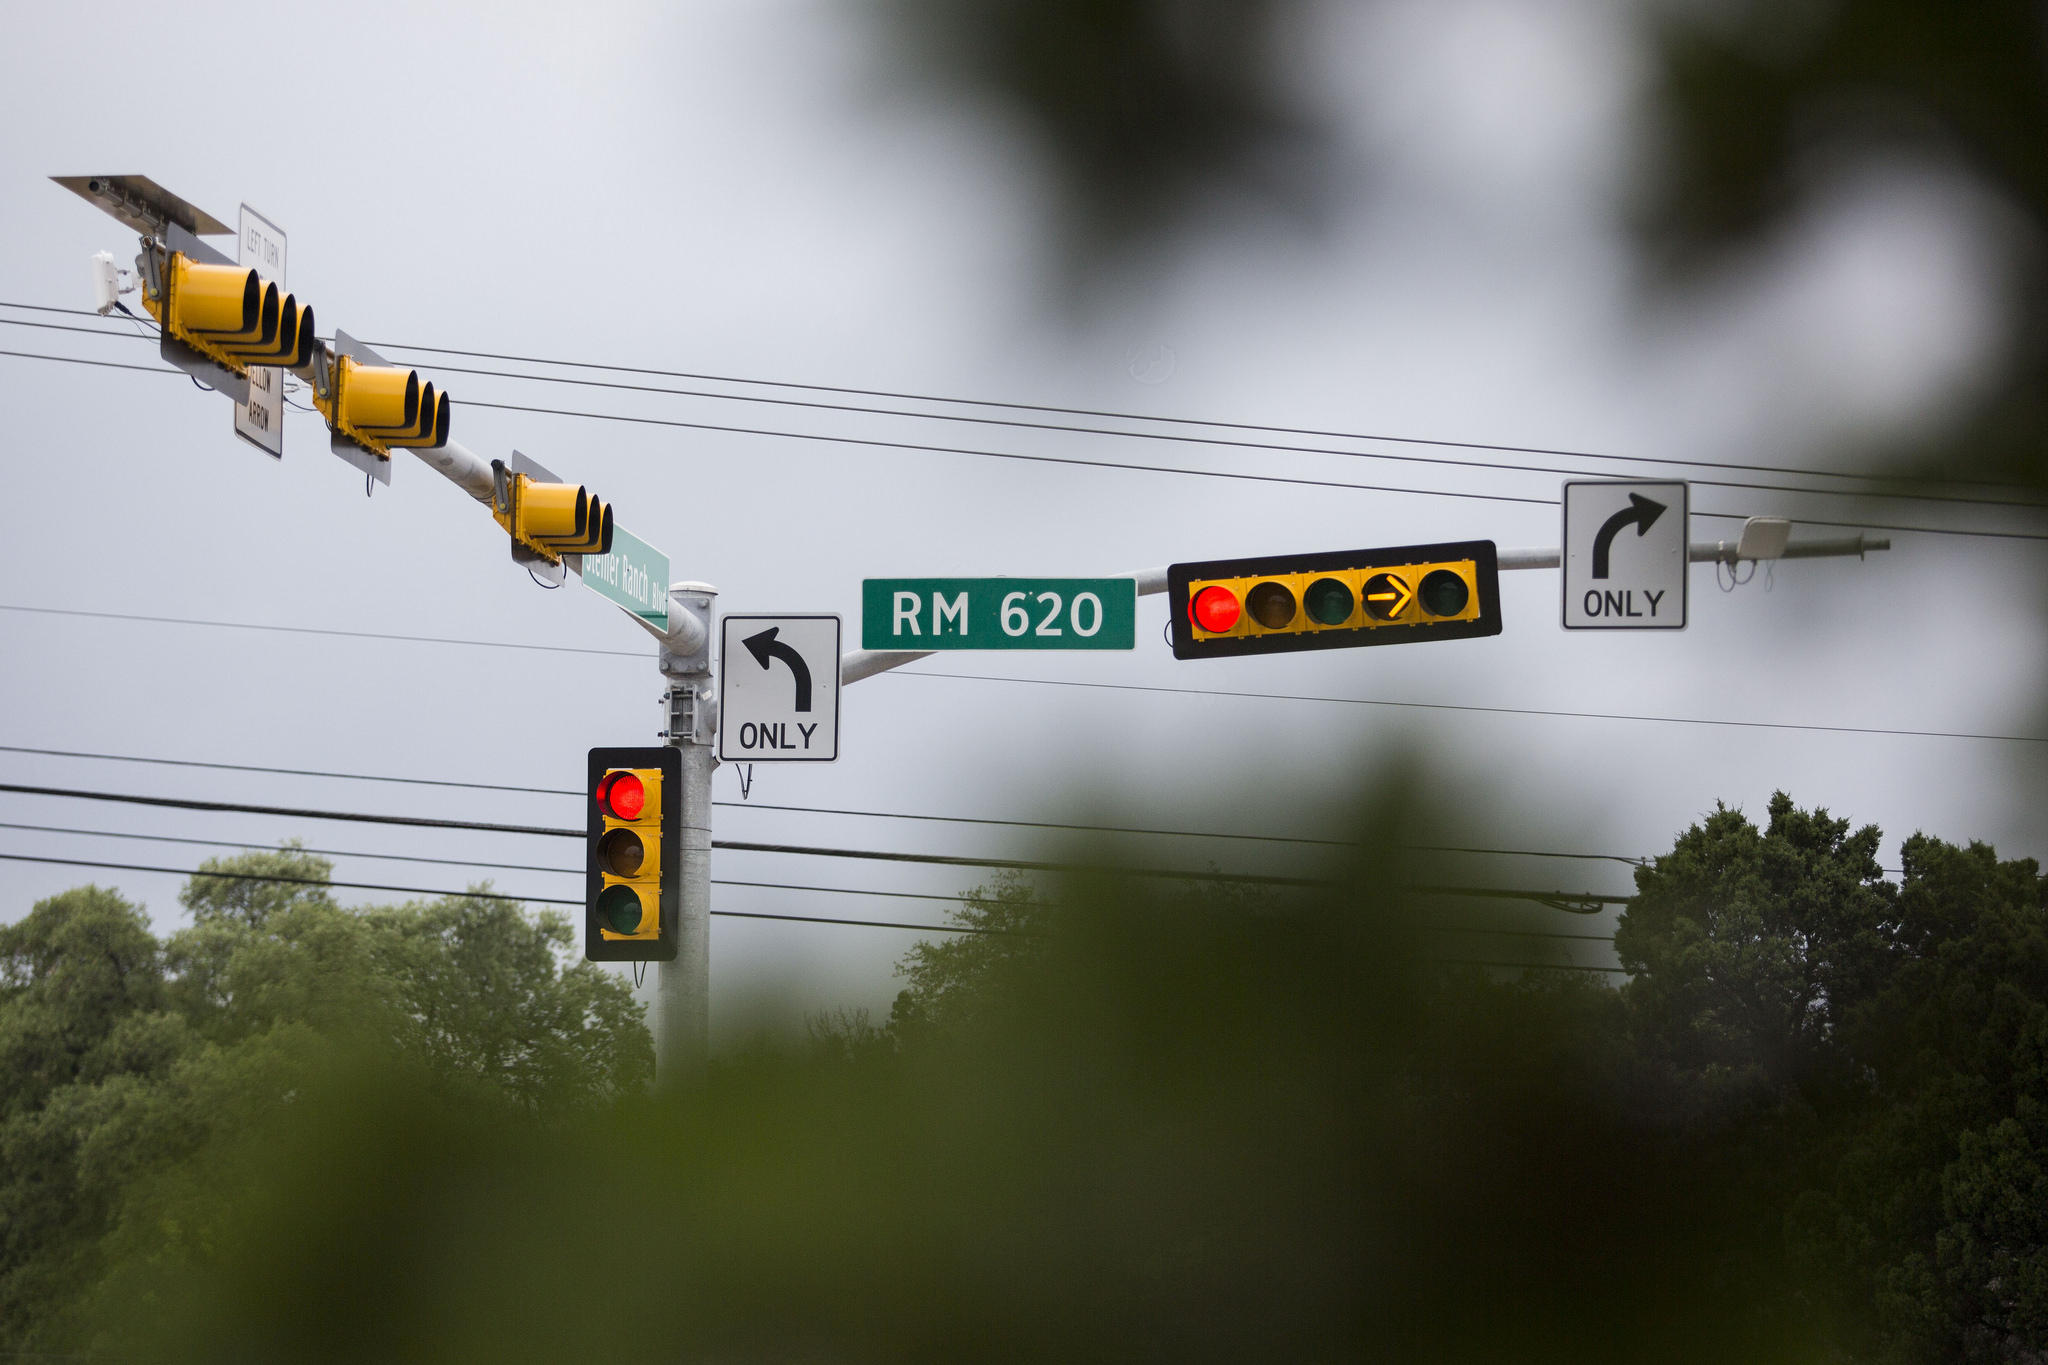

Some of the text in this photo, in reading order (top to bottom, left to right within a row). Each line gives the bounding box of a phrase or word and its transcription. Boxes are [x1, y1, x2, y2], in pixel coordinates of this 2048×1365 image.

[247, 226, 279, 269] LEFT TURN
[251, 365, 272, 394] ELLOW
[248, 400, 270, 432] ARROW
[622, 554, 649, 605] Ranch
[652, 581, 667, 615] Blvd
[893, 591, 1103, 637] RM 620
[1583, 589, 1665, 617] ONLY
[739, 722, 818, 749] ONLY
